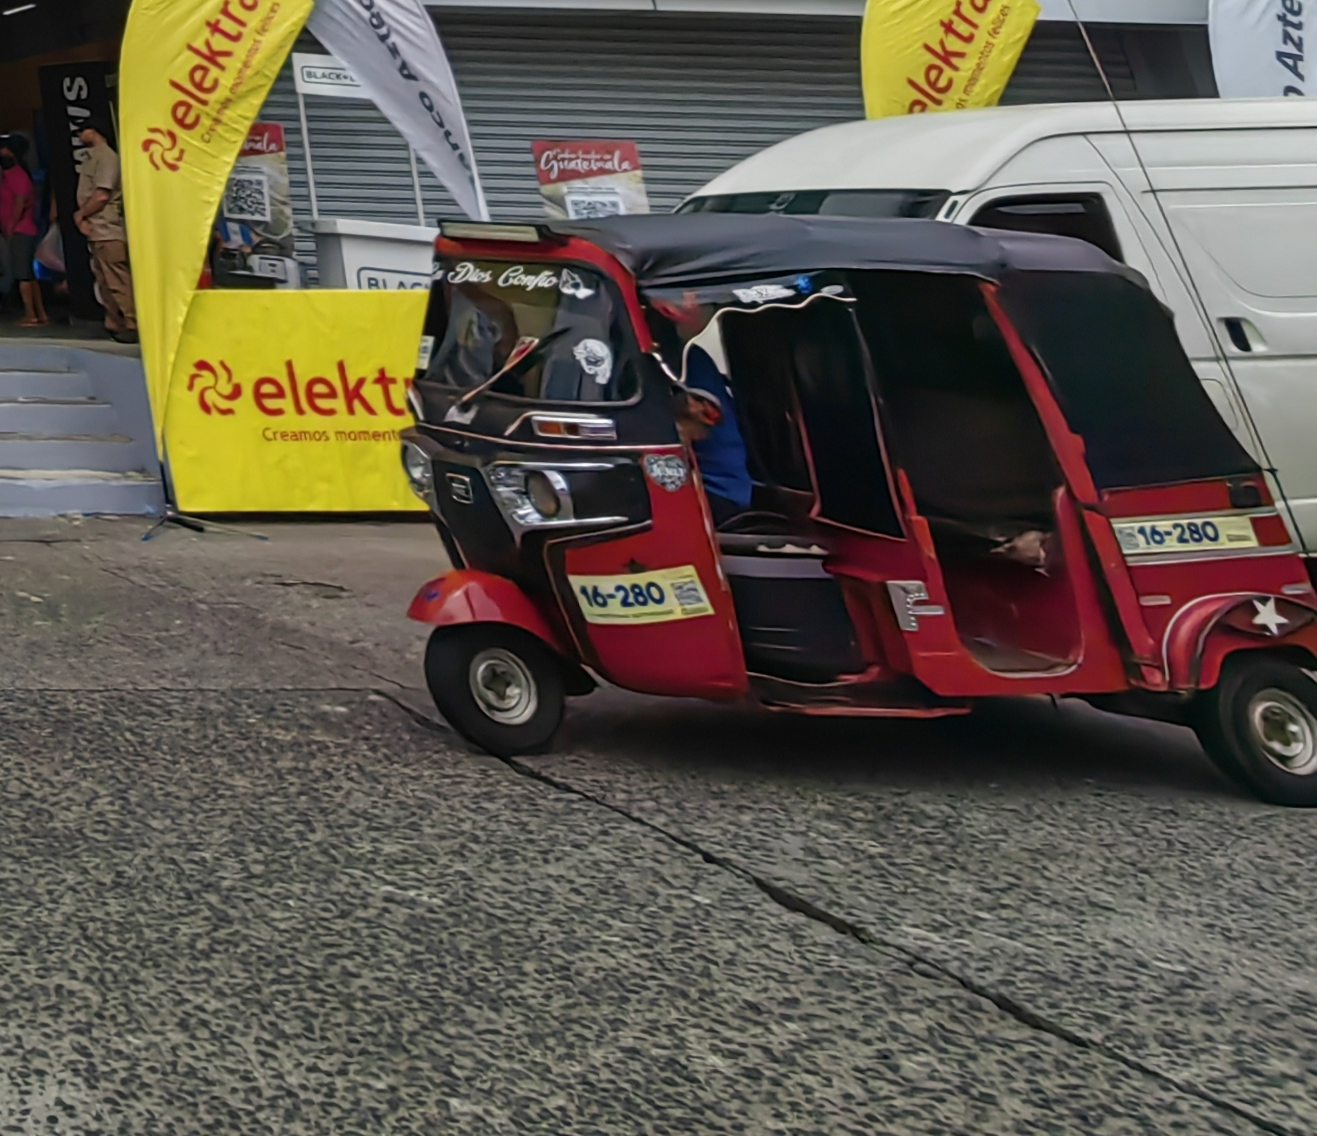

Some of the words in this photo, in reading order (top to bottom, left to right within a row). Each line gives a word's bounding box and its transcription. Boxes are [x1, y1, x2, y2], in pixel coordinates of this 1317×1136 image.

[447, 262, 493, 284] Dios
[252, 359, 413, 417] elekt
[262, 427, 330, 442] Creamos
[335, 430, 401, 442] moment
[1137, 521, 1220, 546] 16-280
[579, 581, 665, 608] 16-280
